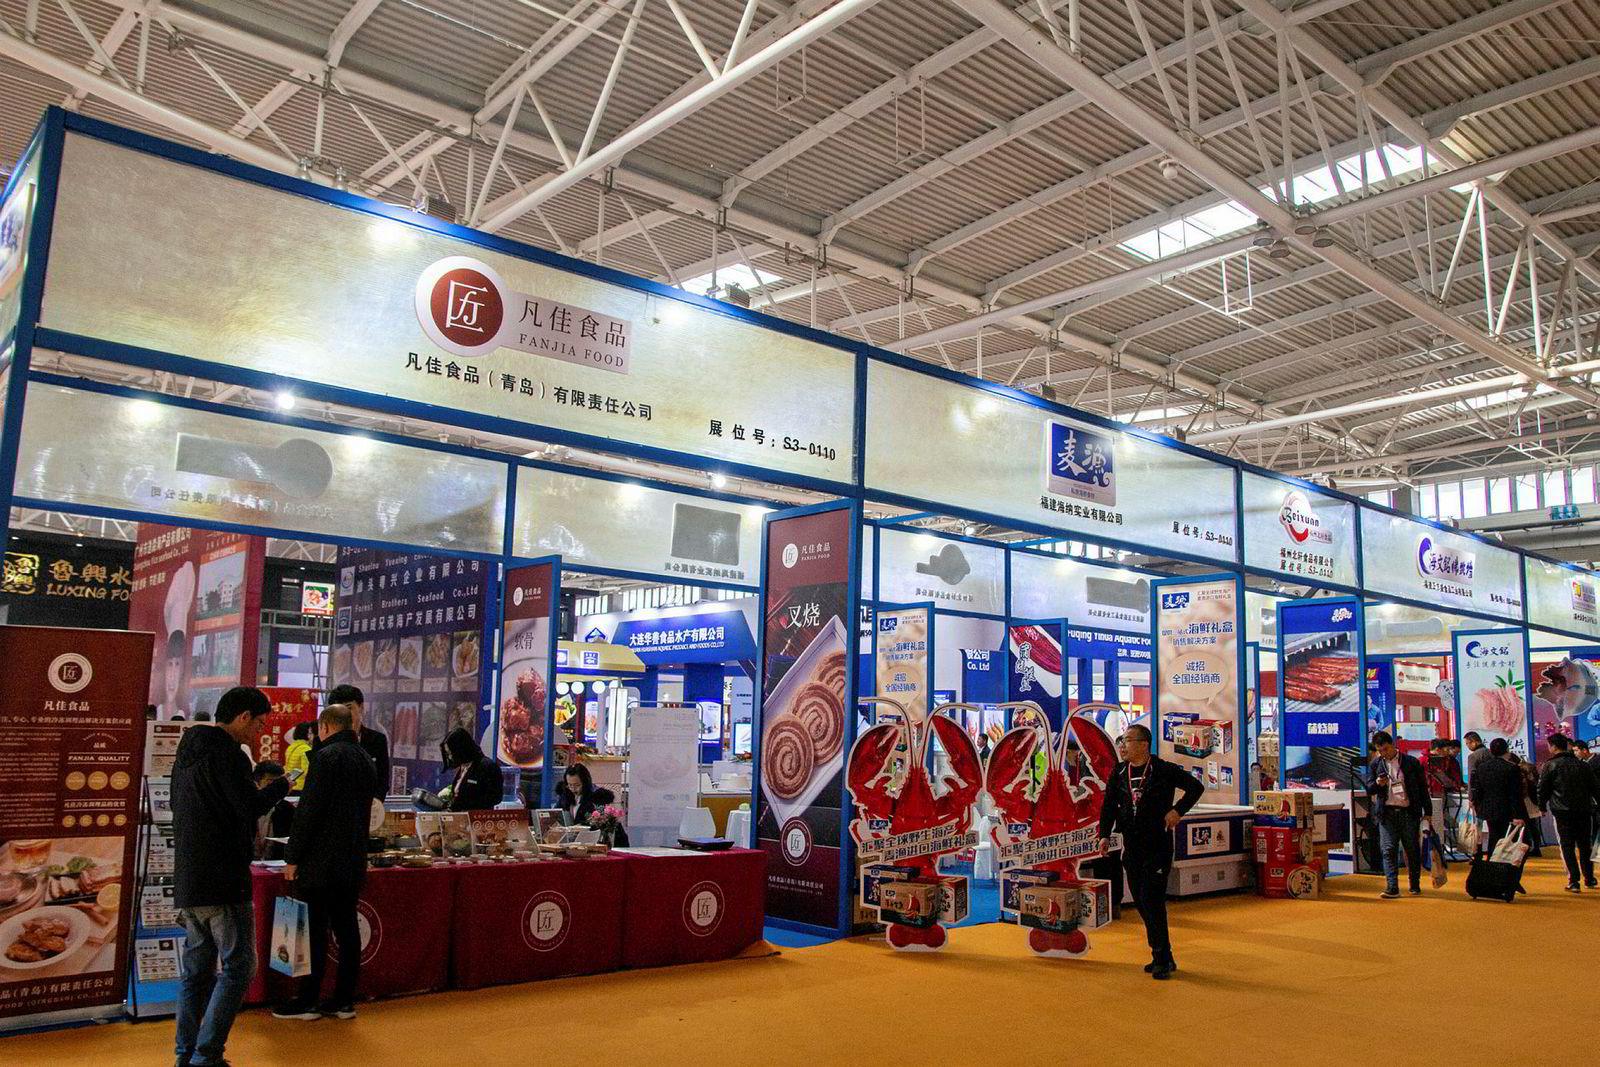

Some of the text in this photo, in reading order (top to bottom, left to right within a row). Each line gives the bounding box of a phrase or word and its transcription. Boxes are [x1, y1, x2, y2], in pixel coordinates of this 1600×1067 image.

[519, 299, 626, 349] 凡佳食品
[519, 333, 624, 368] FANJIA FOOD
[405, 352, 652, 421] 凡佳食品（青岛）有限责任公司
[1040, 495, 1123, 526] 福建海纳实业有限公司
[1281, 506, 1320, 528] Beixuan
[801, 542, 831, 555] 凡佳食品
[46, 583, 105, 599] LUXING
[381, 597, 408, 609] Brothers
[417, 590, 444, 603] Seafood
[788, 602, 820, 628] 叉烧
[1172, 673, 1220, 684] 全国经销商
[44, 700, 90, 712] 凡佳食品
[862, 823, 957, 854] 汇聚全球野生海产
[1001, 826, 1097, 858] 汇聚全球野生海产
